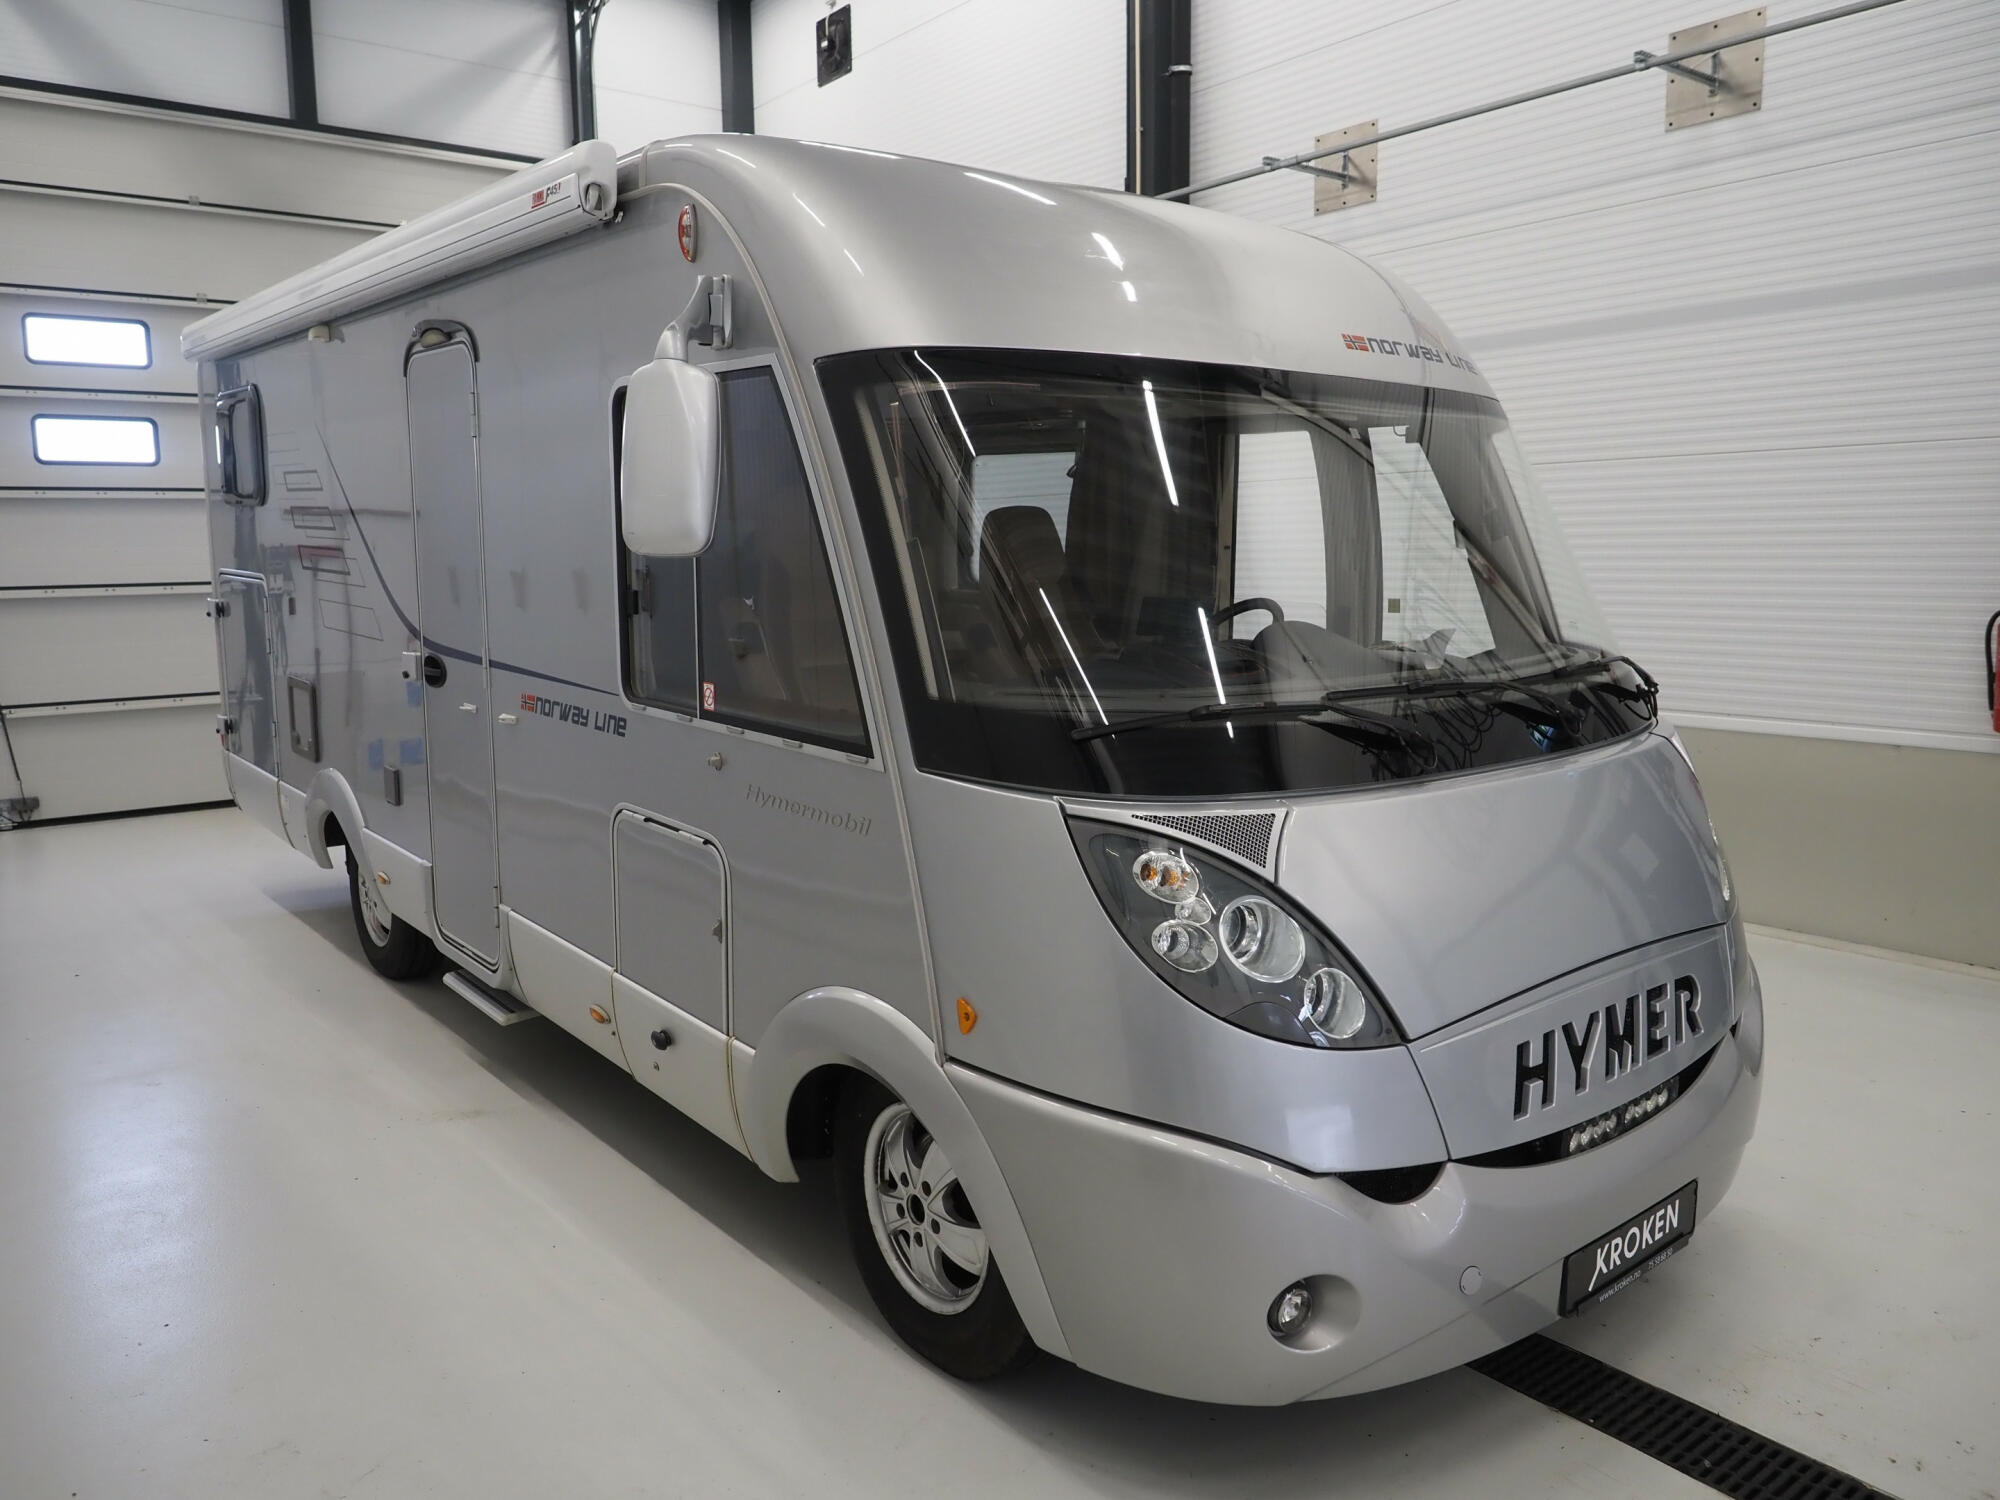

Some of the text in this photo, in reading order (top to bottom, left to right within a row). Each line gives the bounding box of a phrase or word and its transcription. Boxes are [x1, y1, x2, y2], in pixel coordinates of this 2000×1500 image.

[535, 696, 590, 728] norway
[745, 783, 872, 837] Hymermobil
[1513, 973, 1705, 1122] HYMER
[1588, 1199, 1680, 1292] KROKEN
